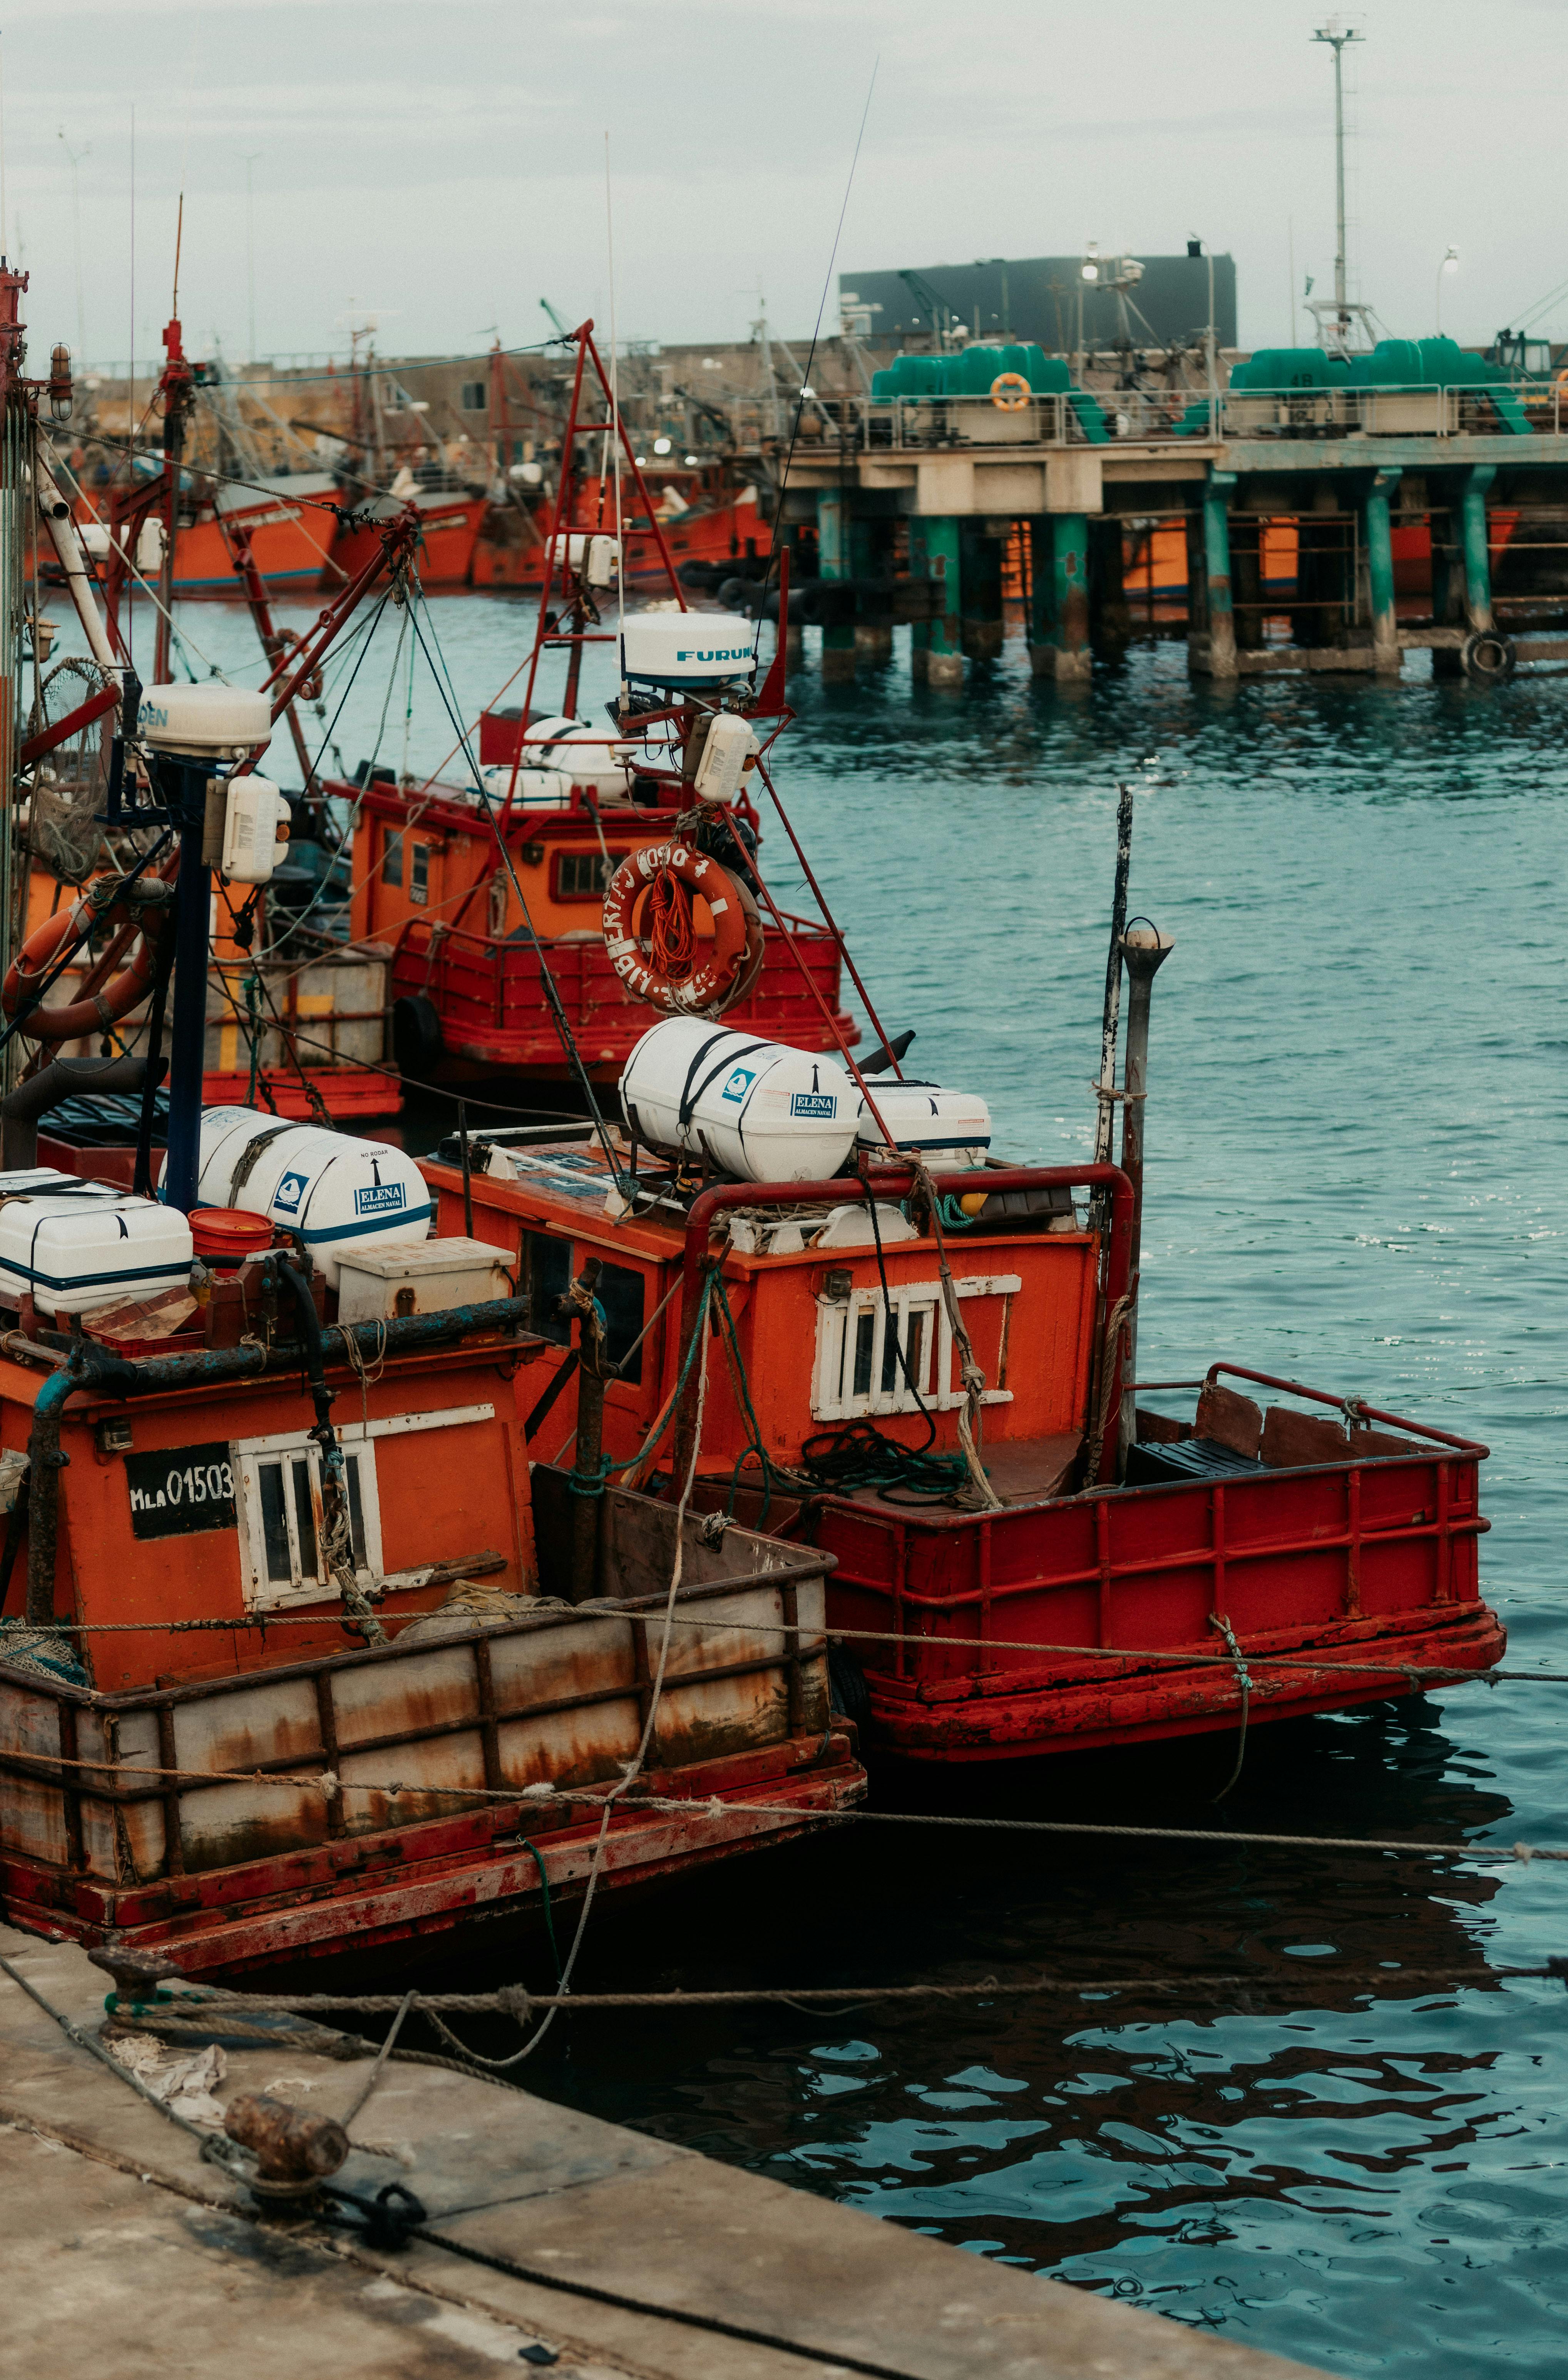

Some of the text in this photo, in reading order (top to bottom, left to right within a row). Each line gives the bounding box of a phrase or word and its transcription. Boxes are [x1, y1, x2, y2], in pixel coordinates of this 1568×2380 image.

[677, 646, 752, 661] FURUN
[137, 705, 168, 727] DEN
[796, 1096, 832, 1109] ELENA
[360, 1186, 401, 1203] ELENA
[361, 1202, 385, 1211] ALMACEN
